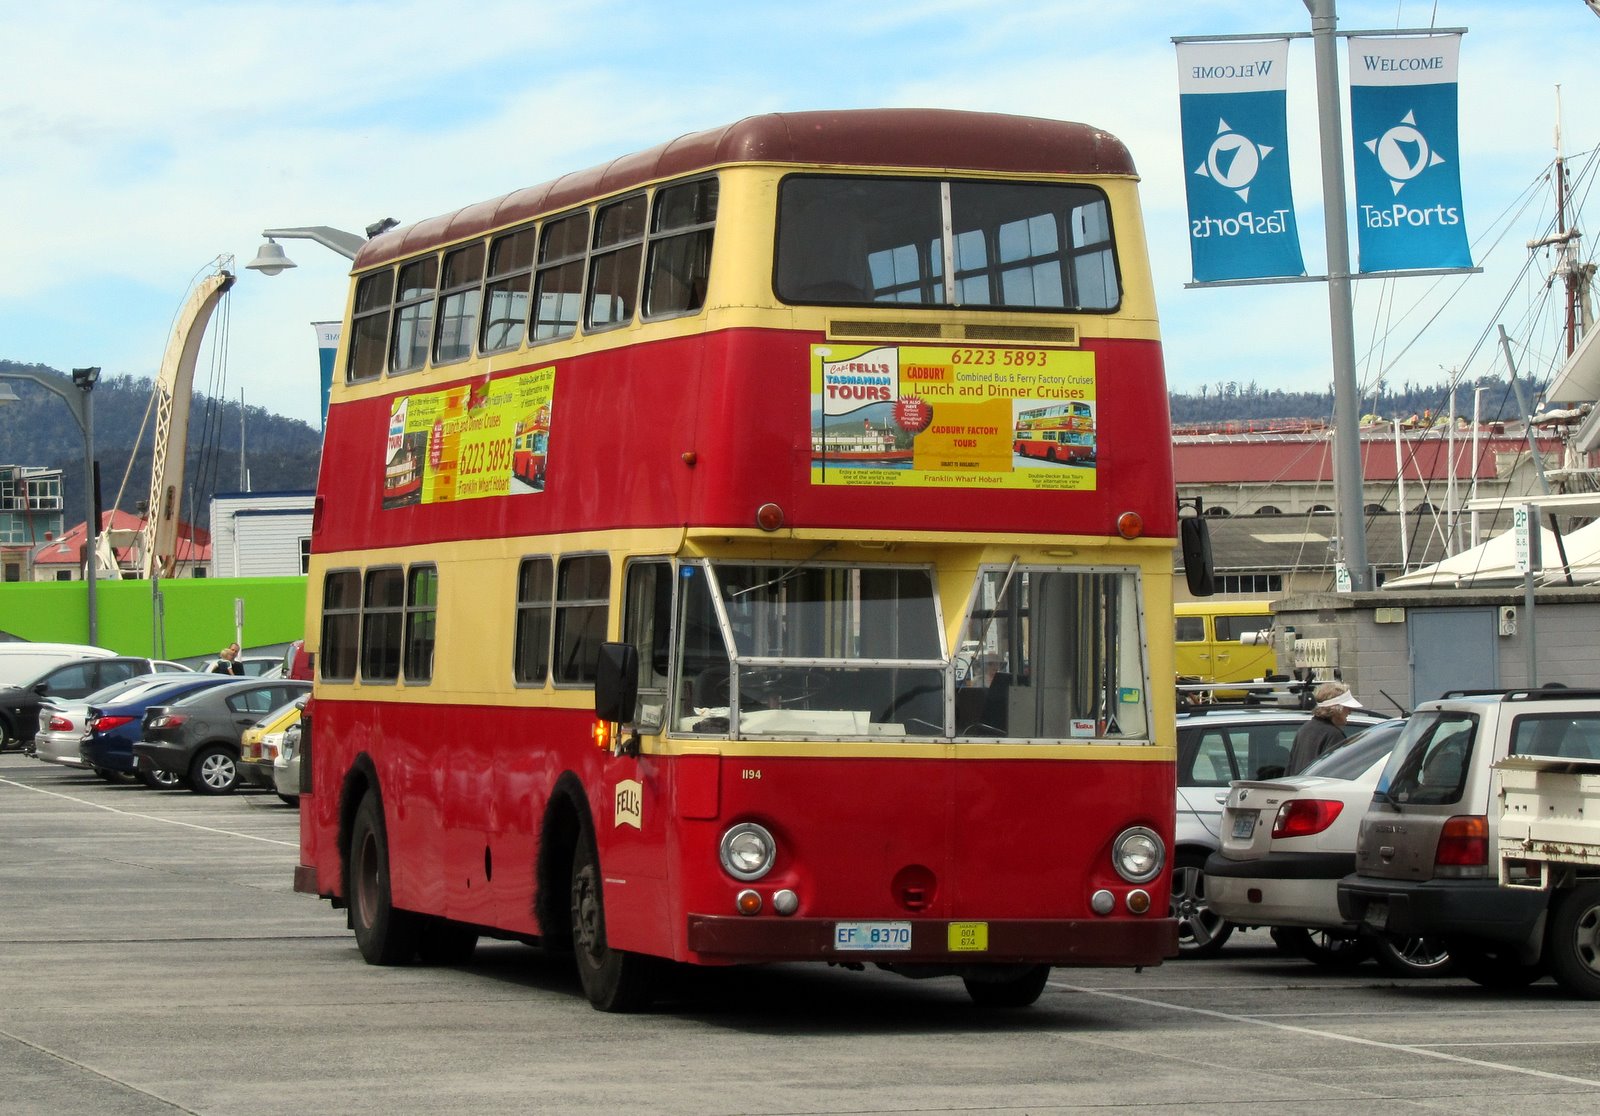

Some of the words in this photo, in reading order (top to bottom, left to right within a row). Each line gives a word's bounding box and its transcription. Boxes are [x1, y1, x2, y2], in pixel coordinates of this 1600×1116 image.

[1363, 55, 1443, 72] WELCOME
[1360, 203, 1459, 229] TasPorts
[951, 349, 996, 365] 6223
[1003, 350, 1047, 366] 5893
[849, 363, 890, 373] FELL'S
[907, 367, 945, 380] CADBURY
[826, 375, 891, 385] TASMANIAN
[956, 372, 992, 382] Combined
[994, 373, 1007, 382] Bus
[1009, 374, 1014, 382] &
[1017, 374, 1037, 385] Ferry
[1038, 374, 1066, 385] Factory
[1067, 375, 1093, 384] Cruises
[827, 385, 891, 400] TOURS
[914, 382, 954, 395] Lunch
[959, 384, 983, 396] and
[988, 384, 1032, 397] Dinner
[1037, 385, 1084, 398] Cruises
[931, 425, 965, 434] CADBURY
[967, 426, 998, 435] FACTORY
[953, 439, 977, 447] TOURS
[461, 442, 485, 475] 6223
[486, 437, 512, 472] 5893
[1515, 511, 1527, 527] 2P
[742, 769, 762, 780] 1194
[617, 789, 640, 817] FELL'S
[838, 928, 857, 943] EF
[870, 928, 909, 943] 8370
